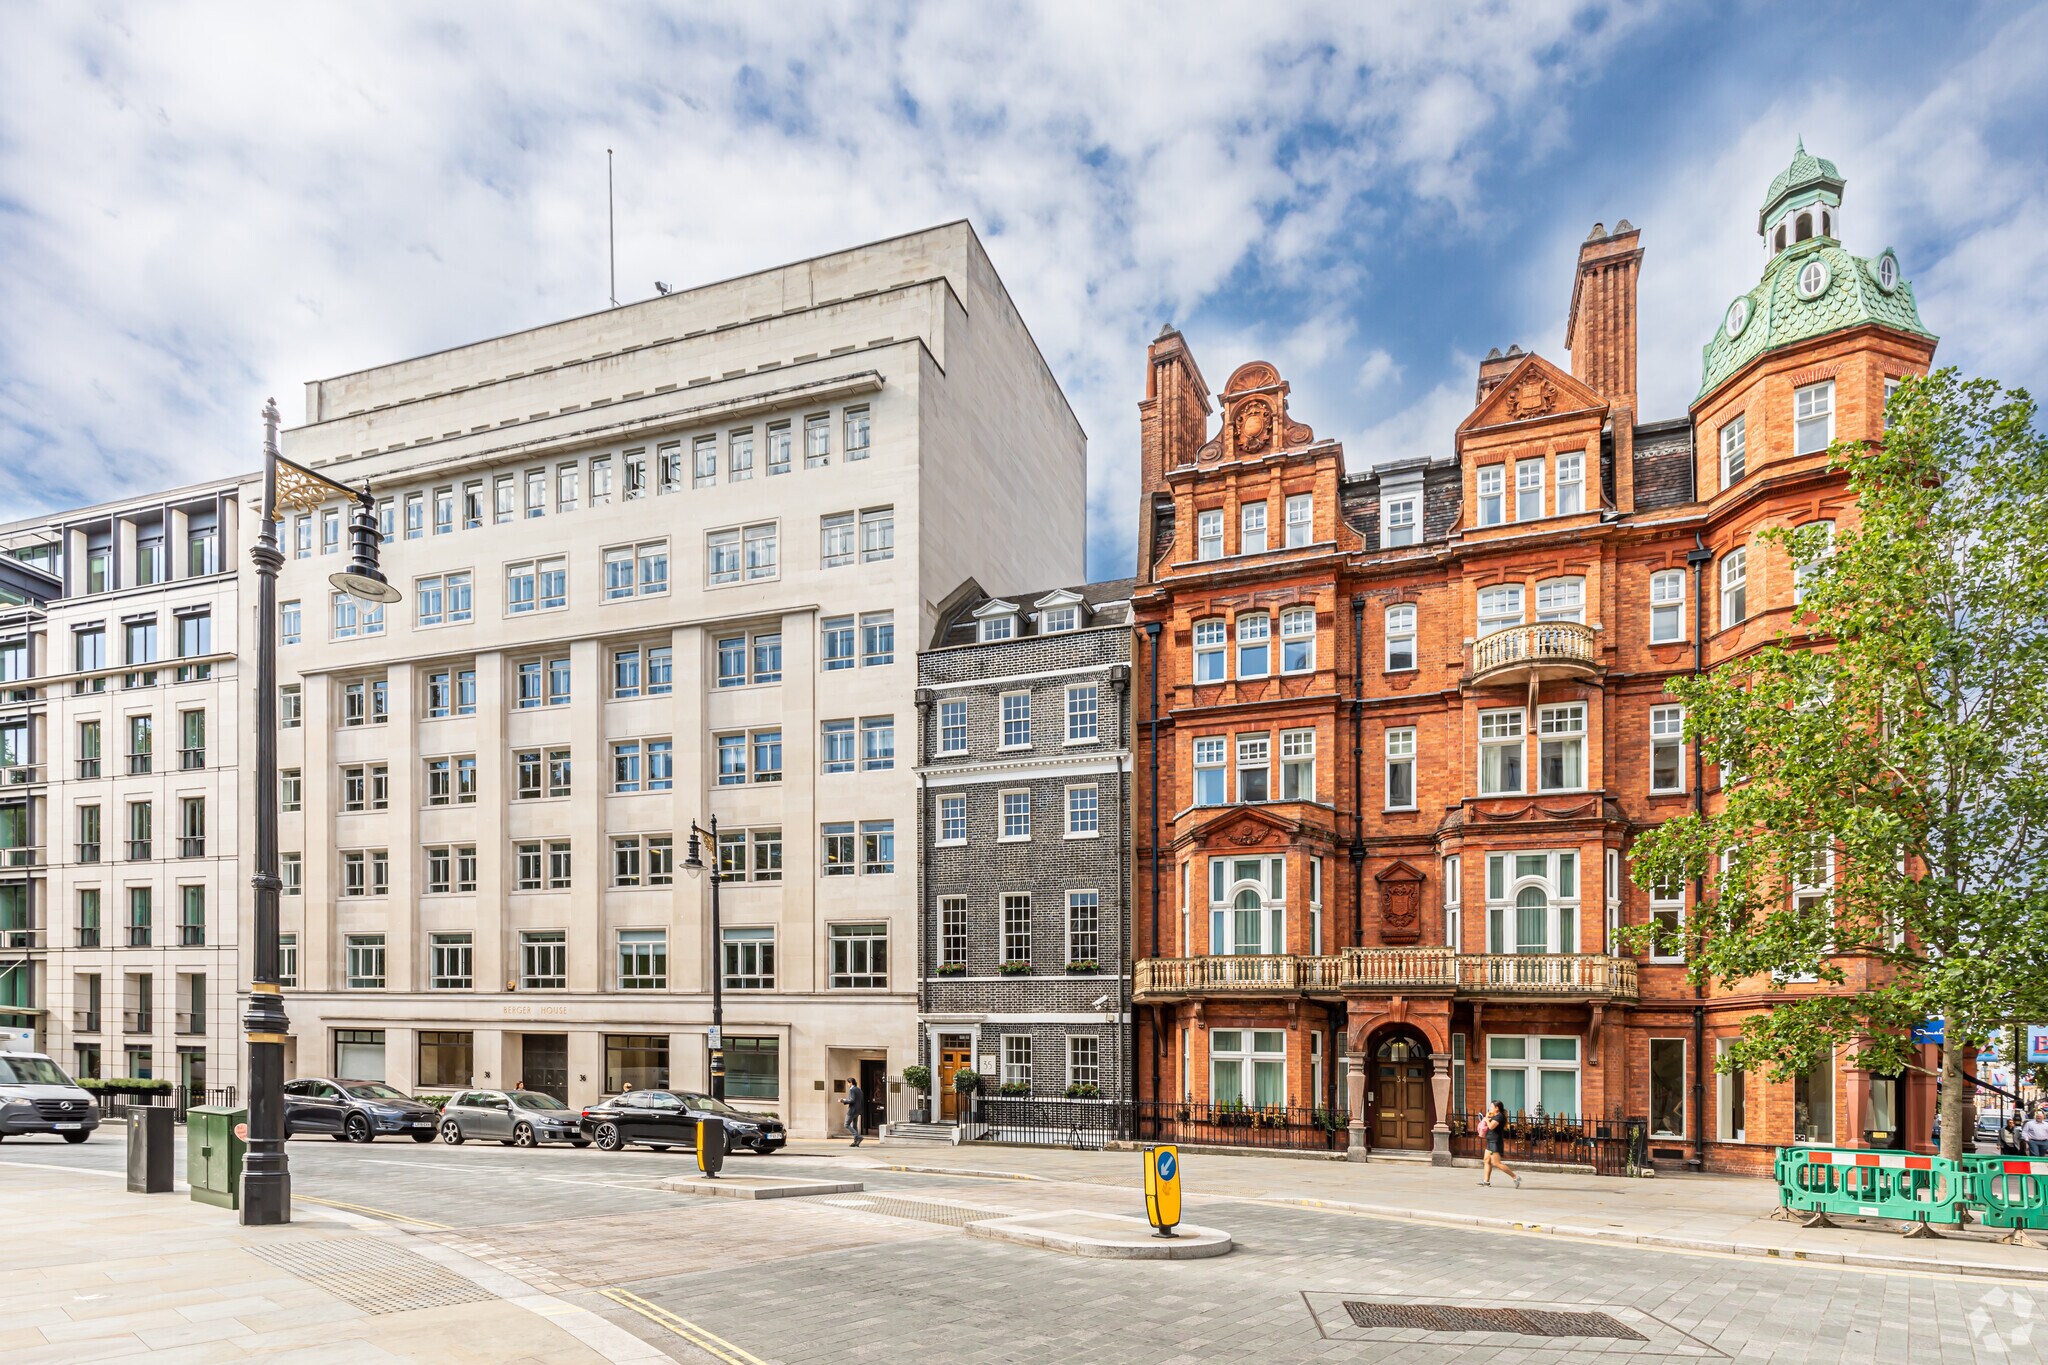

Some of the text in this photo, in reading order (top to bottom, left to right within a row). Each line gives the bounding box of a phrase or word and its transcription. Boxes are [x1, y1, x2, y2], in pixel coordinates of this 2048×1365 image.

[503, 1006, 567, 1015] BERGER HOUSE
[983, 1060, 993, 1070] 35
[484, 1071, 491, 1079] 38
[579, 1074, 587, 1082] 36
[1396, 1075, 1407, 1083] 34
